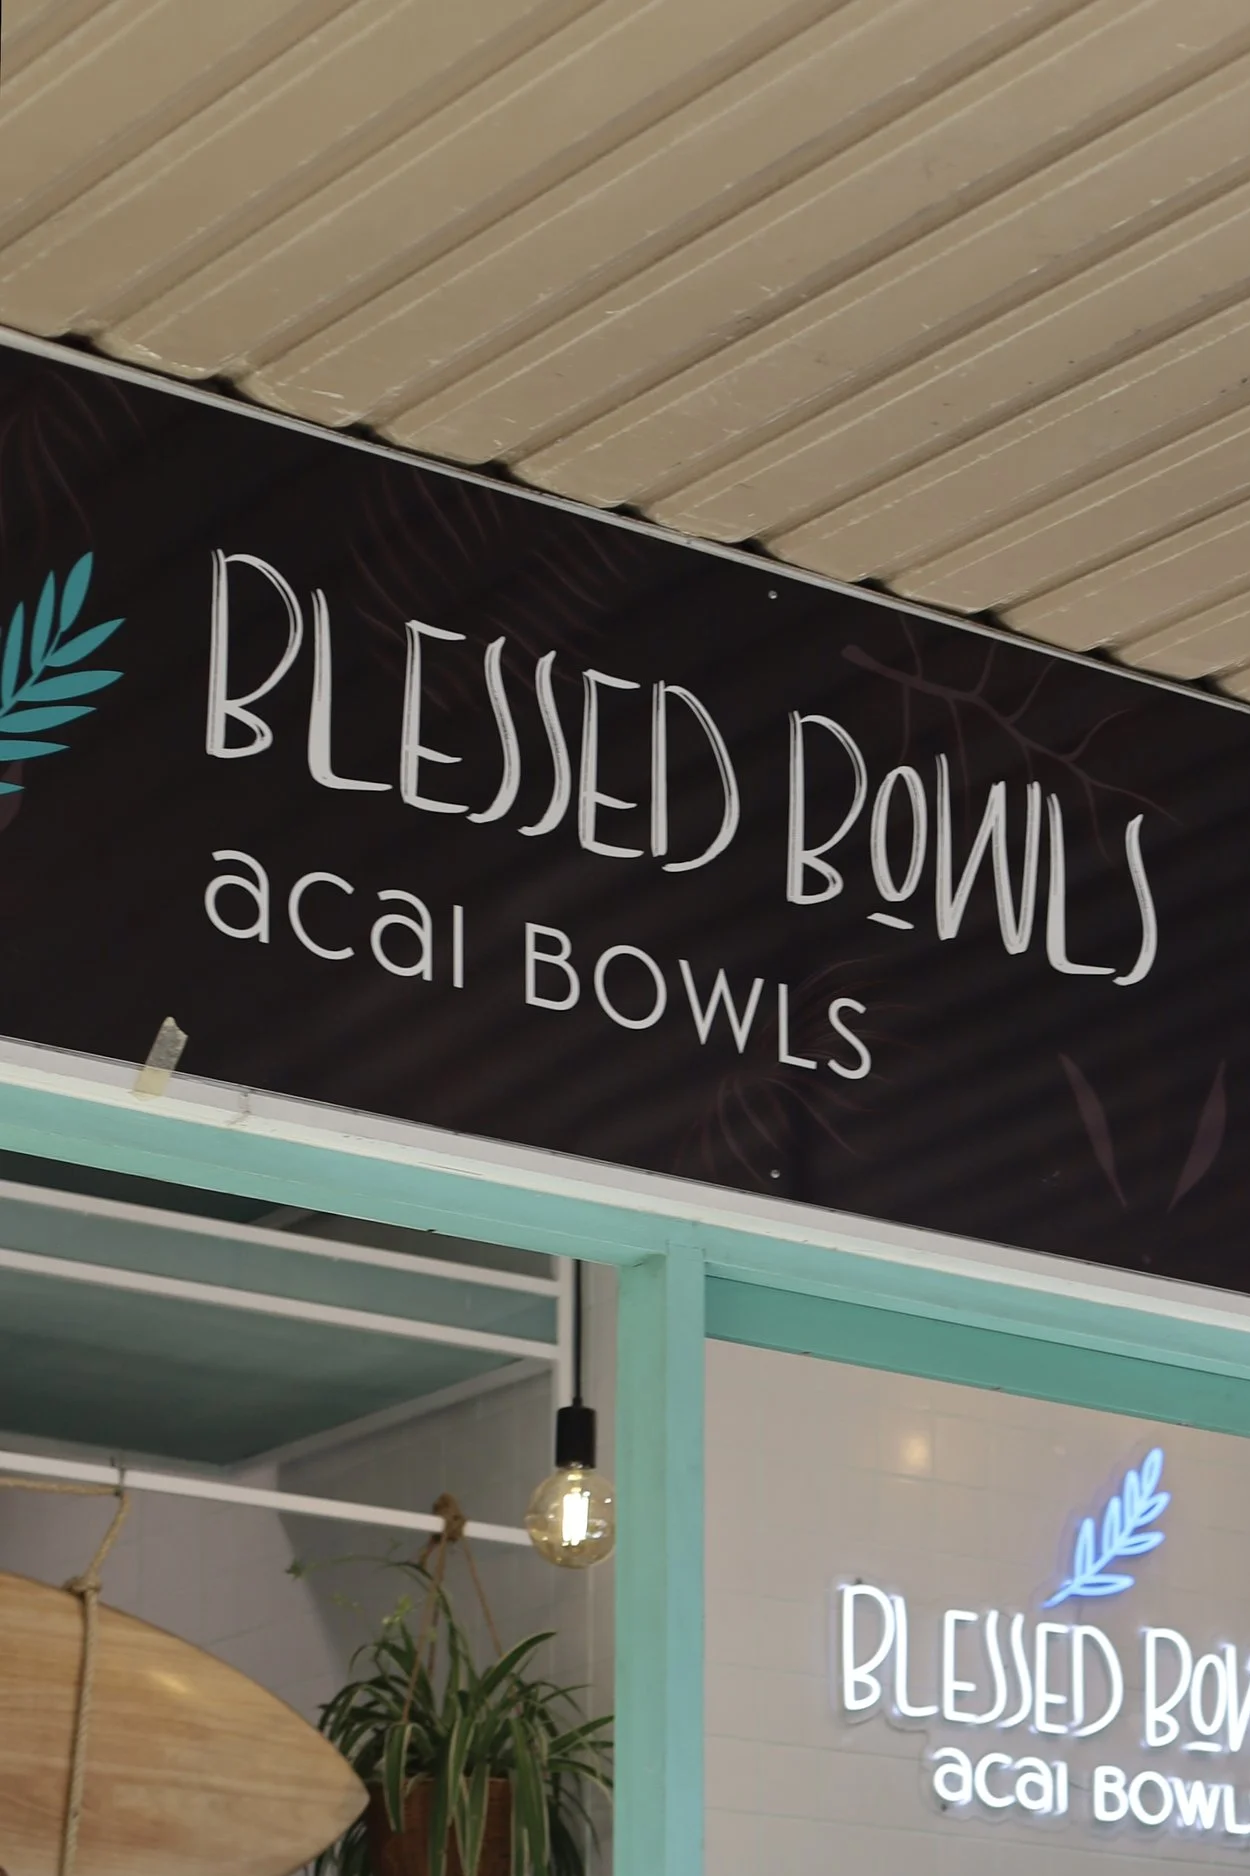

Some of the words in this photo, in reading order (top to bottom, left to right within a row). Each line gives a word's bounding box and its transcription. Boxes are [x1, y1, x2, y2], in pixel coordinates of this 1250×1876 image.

[205, 549, 741, 872] BLESSED
[786, 710, 1158, 987] BOWLS
[524, 921, 872, 1080] BOWLS
[841, 1582, 1123, 1737] BLESSED
